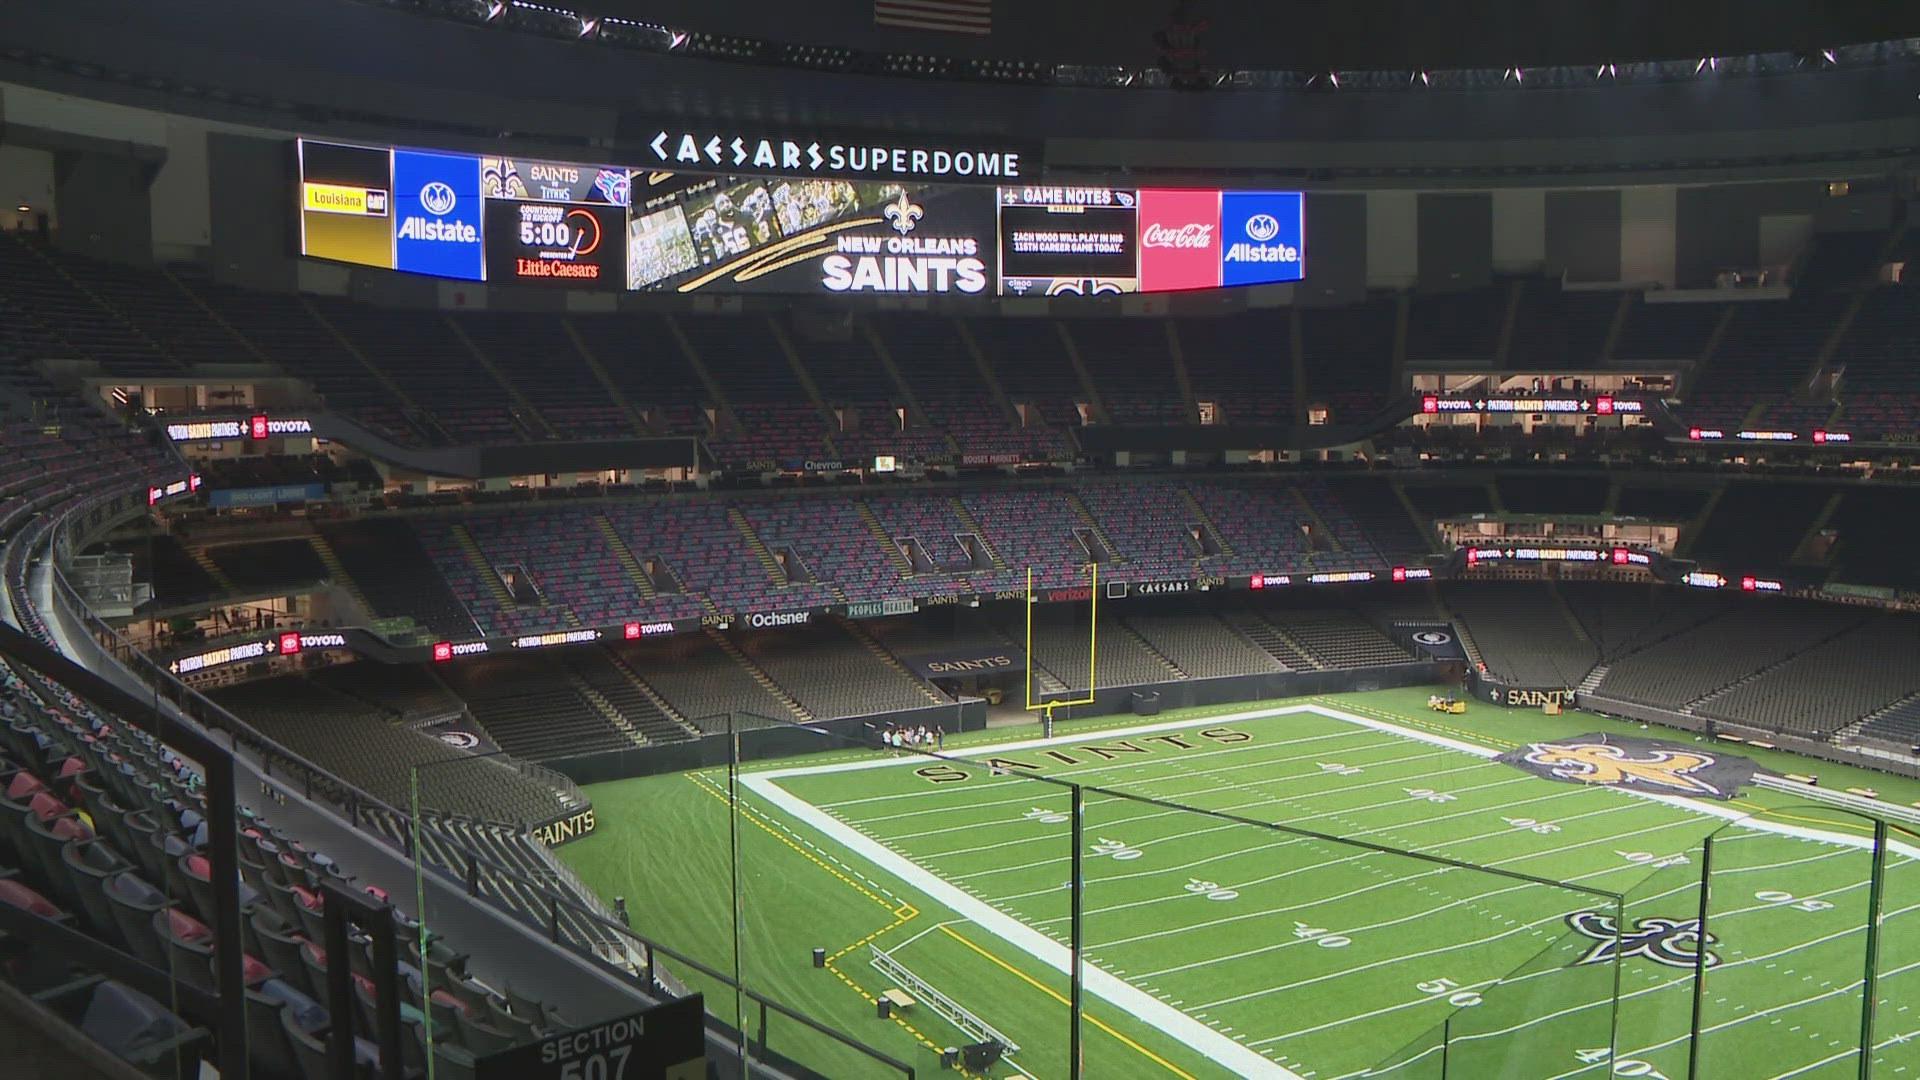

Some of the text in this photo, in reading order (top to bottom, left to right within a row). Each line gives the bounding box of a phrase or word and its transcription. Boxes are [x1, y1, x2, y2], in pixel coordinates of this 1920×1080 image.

[650, 131, 1019, 177] CAESARS SUPERDOME
[531, 166, 579, 184] SAINTS
[314, 191, 361, 207] Louisiana
[1023, 188, 1111, 205] GAME NOTES
[521, 221, 570, 246] 5:00
[1013, 232, 1123, 243] ZACH WOOD WILL PLAY IN HIS
[837, 236, 977, 256] NEW ORLEANS
[1040, 243, 1070, 253] CAREER
[1072, 243, 1093, 253] GAME
[518, 259, 598, 278] Little Caesars
[822, 255, 986, 293] SAINTS
[1437, 400, 1642, 412] TOYOTA PATRON SAINTS PARTNERS TOYOTA
[188, 423, 211, 439] SAINTS
[211, 422, 239, 437] PARTNERS
[267, 421, 311, 433] TOYOTA
[1825, 433, 1849, 441] TOYOTA
[804, 460, 842, 470] Chevron
[963, 454, 1019, 464] ROUSES MARKETS
[1476, 549, 1649, 564] TOYOTA PATRON SAINTS PARTNERS TOYOTA
[1263, 576, 1290, 585] TOYOTA
[1405, 569, 1430, 578] TOYOTA
[1138, 581, 1189, 594] CAESARS
[1754, 581, 1781, 590] TOYOTA
[927, 595, 958, 605] SAINTS
[995, 590, 1025, 600] SAINTS
[849, 601, 913, 616] PEOPLES HEALTH
[701, 614, 735, 625] SAINTS
[752, 610, 809, 628] Ochsner
[641, 623, 674, 634] TOYOTA
[518, 631, 595, 648] PATRON SAINTS PARTNERS
[180, 635, 345, 673] PATRON SAINTS PARTNERS TOYOTA
[451, 642, 488, 655] TOYOTA
[928, 656, 1011, 673] SAINTS
[914, 727, 1253, 784] SAINTS
[532, 810, 595, 846] SAINTS
[542, 1016, 645, 1063] SECTION
